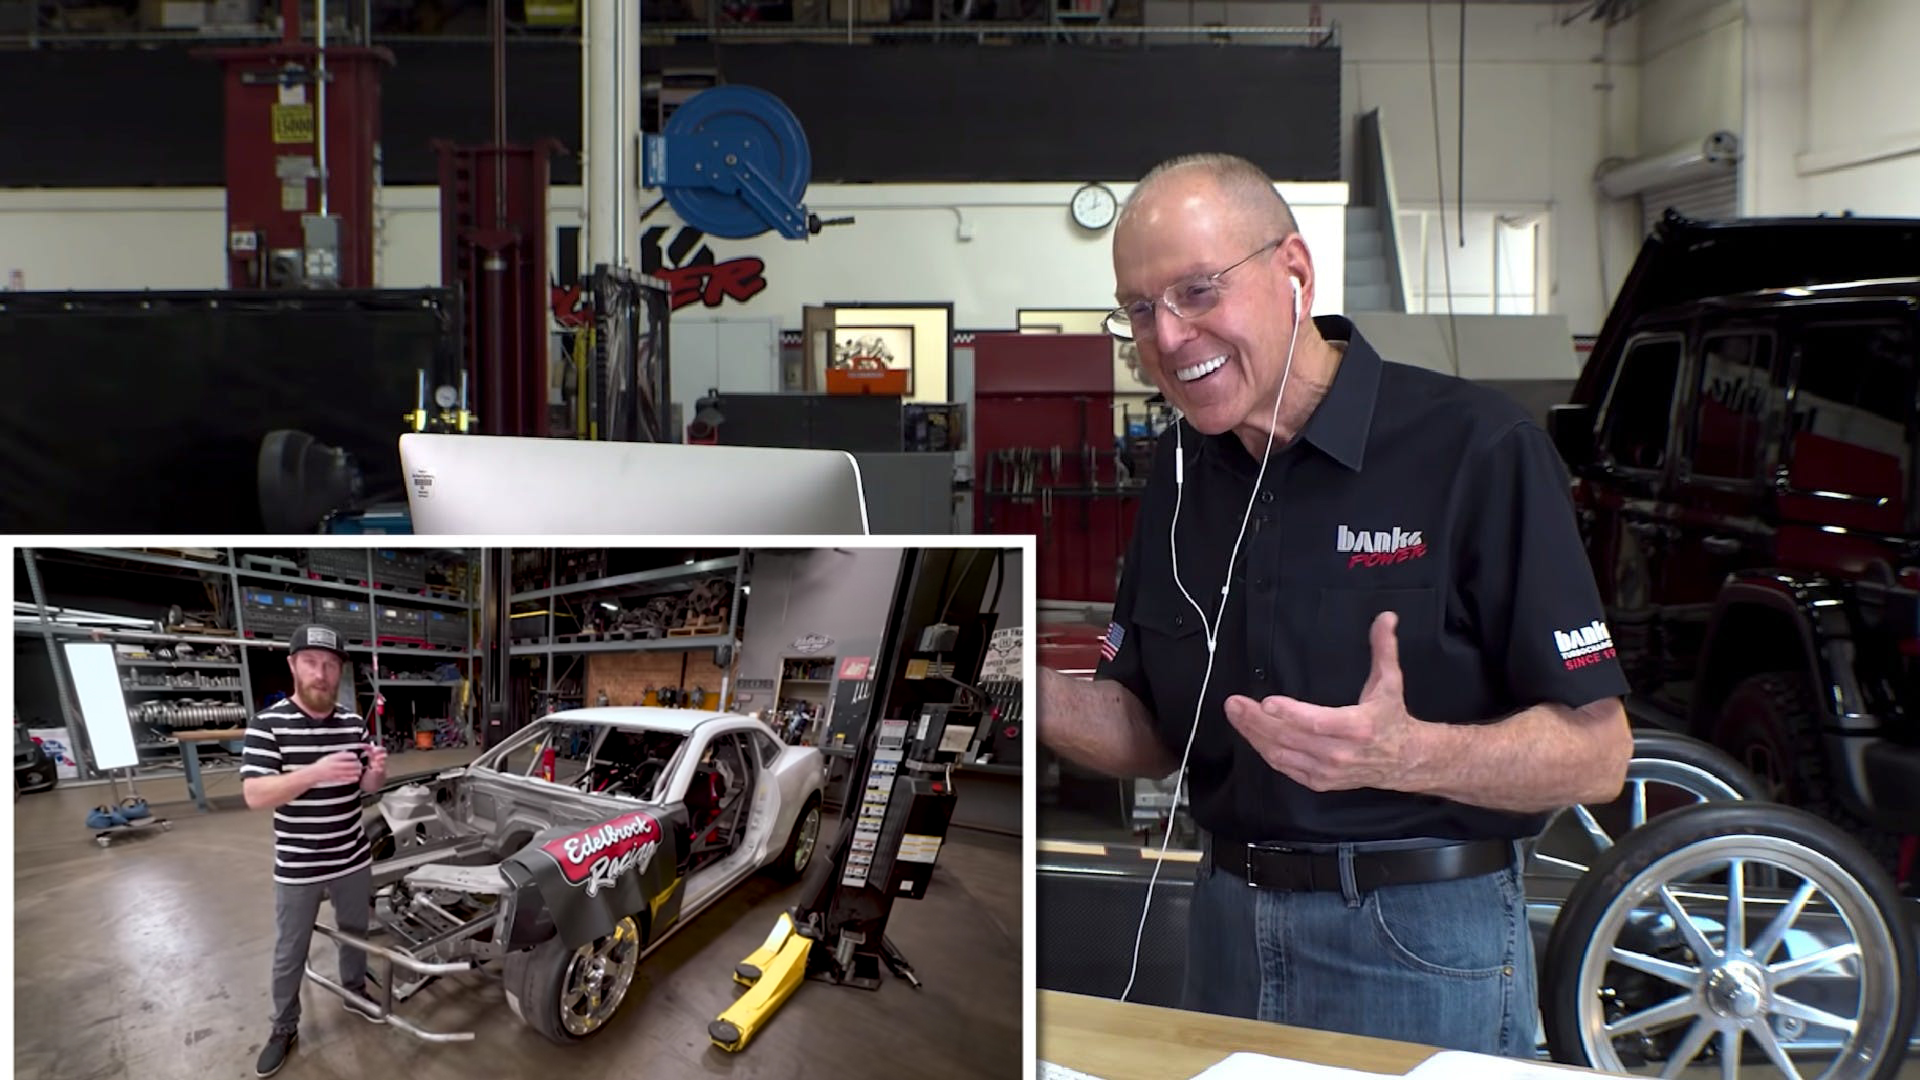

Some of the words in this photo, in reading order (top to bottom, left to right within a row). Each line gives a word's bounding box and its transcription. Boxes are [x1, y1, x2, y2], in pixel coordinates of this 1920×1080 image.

[1347, 543, 1427, 569] POWER
[1553, 620, 1611, 652] bank
[1564, 652, 1601, 671] SINCE
[564, 816, 652, 864] Edelbrock
[586, 841, 656, 896] Racing
